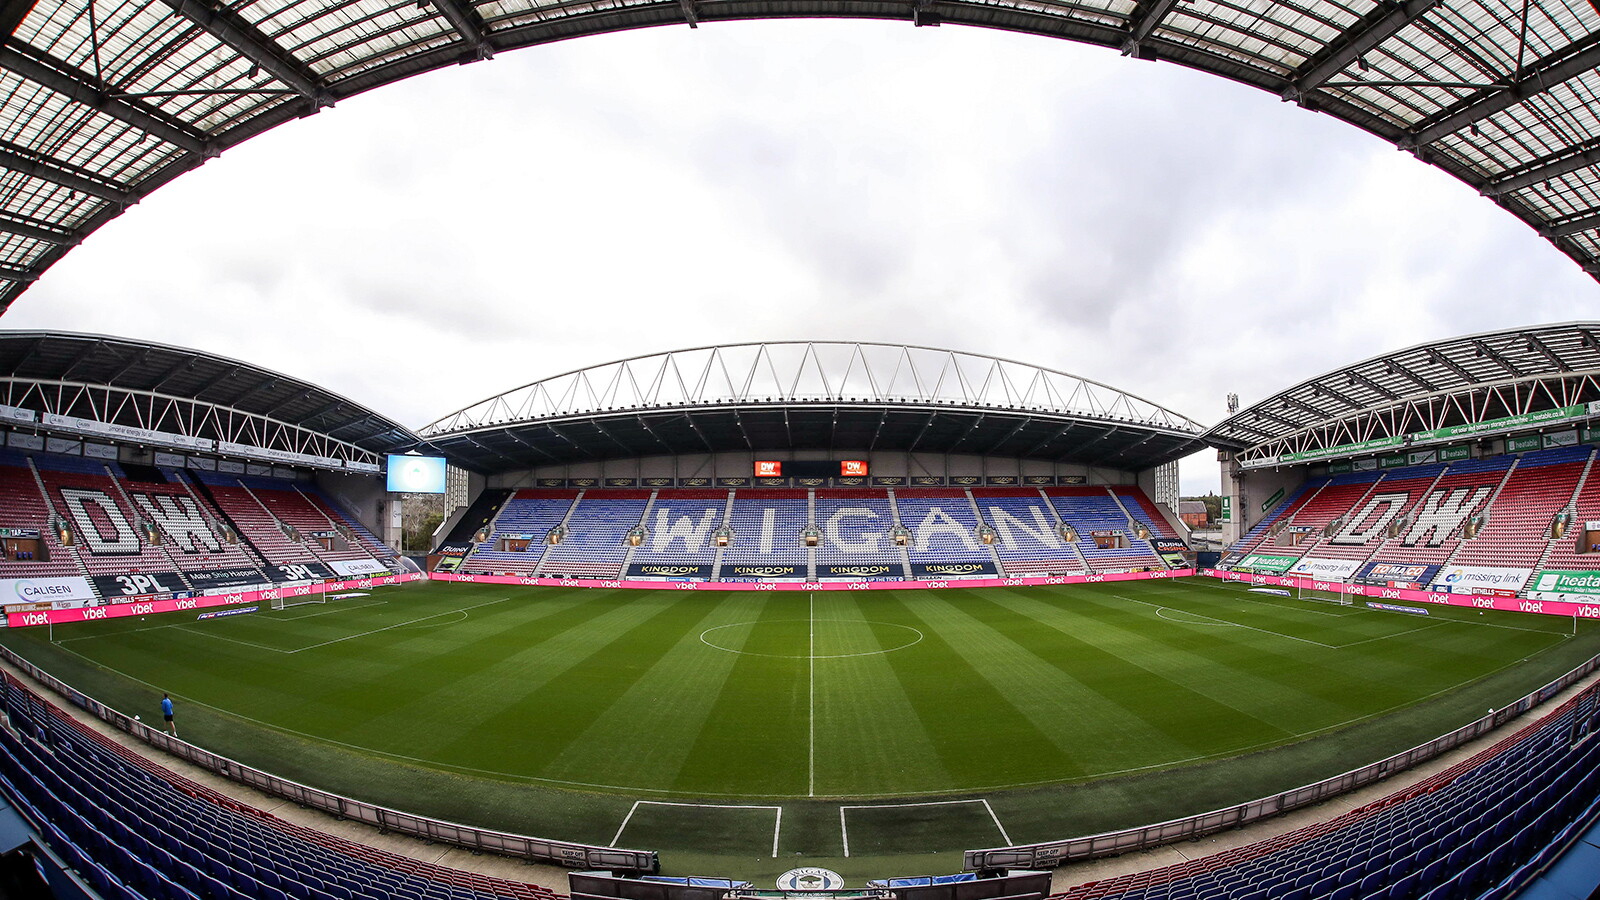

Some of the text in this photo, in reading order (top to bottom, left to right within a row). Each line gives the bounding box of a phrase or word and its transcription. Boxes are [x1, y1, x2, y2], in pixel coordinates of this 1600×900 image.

[1515, 440, 1538, 448] heatable
[1447, 449, 1467, 458] heatable
[652, 506, 1062, 553] WIGAN
[228, 570, 258, 578] Happen
[279, 564, 320, 580] 3PL
[1253, 574, 1266, 583] vbet
[1280, 577, 1294, 586] vbet
[1464, 572, 1522, 584] missing link
[116, 574, 170, 595] 3PL
[330, 582, 345, 591] vbet
[1314, 582, 1330, 591] vbet
[1346, 584, 1364, 594] vbet
[24, 585, 72, 596] CALISEN
[260, 590, 278, 600] vbet
[294, 585, 311, 595] vbet
[1382, 589, 1400, 598] vbet
[224, 594, 243, 604] vbet
[1428, 593, 1449, 603] vbet
[1472, 596, 1495, 608] vbet
[131, 602, 153, 615] vbet
[176, 598, 197, 610] vbet
[1519, 600, 1543, 612] vbet
[83, 606, 107, 619] vbet
[1578, 605, 1600, 617] vbe
[22, 612, 49, 625] vbet
